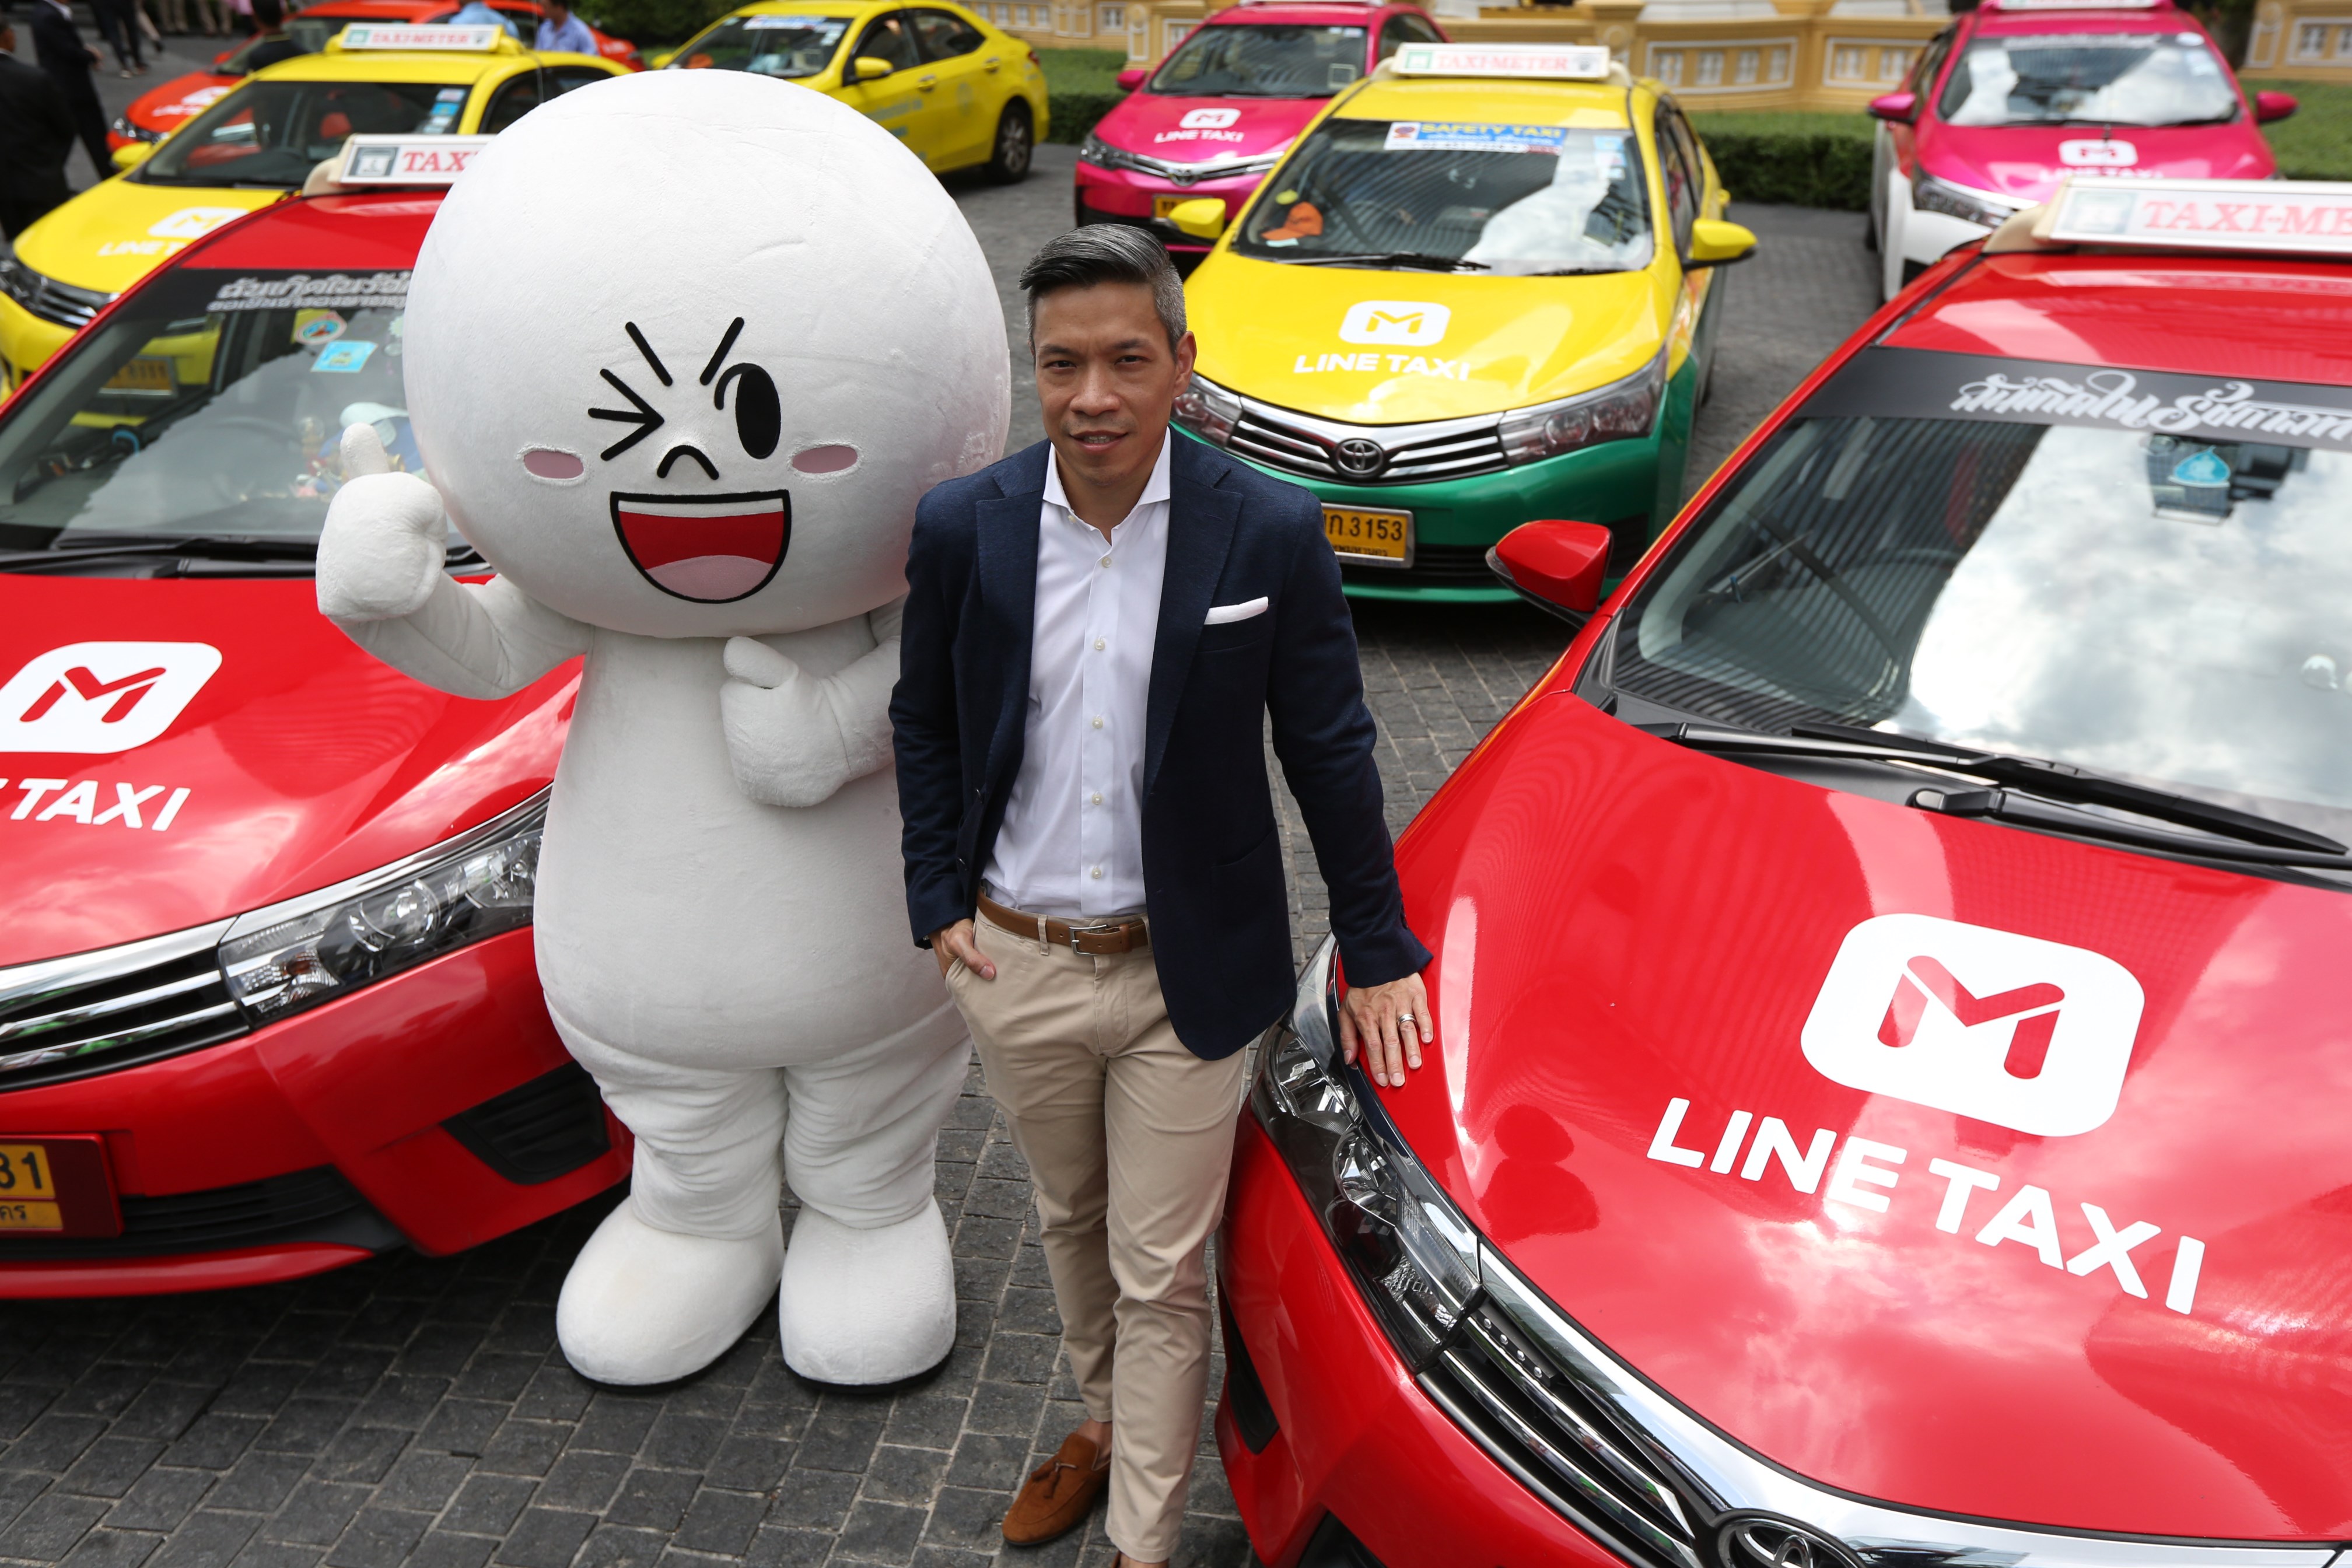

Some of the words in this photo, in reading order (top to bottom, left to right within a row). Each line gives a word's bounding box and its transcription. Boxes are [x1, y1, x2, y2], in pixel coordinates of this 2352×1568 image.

[1153, 130, 1200, 144] LINE
[1200, 130, 1245, 143] TAXI
[1421, 124, 1506, 135] SAFETY
[1513, 126, 1562, 138] TAXI
[96, 240, 167, 257] LINE
[1293, 352, 1381, 374] LINE
[1385, 354, 1471, 382] TAXI
[1349, 516, 1402, 541] 3153
[10, 778, 191, 832] TAXI
[1646, 1097, 1908, 1213] LINE
[1928, 1157, 2206, 1315] TAXI
